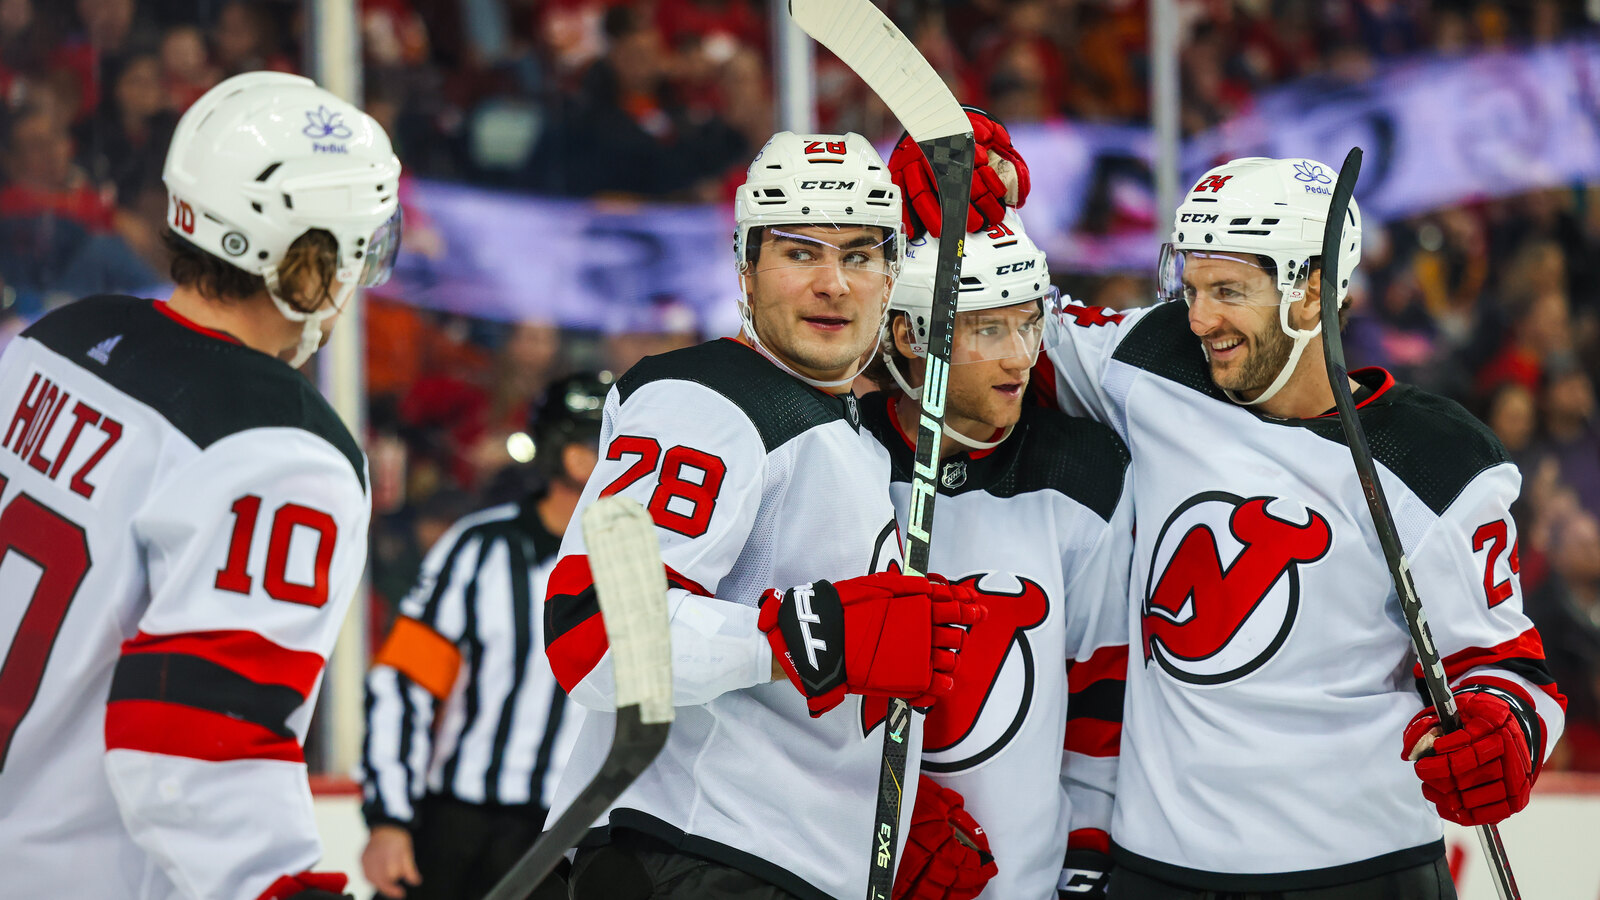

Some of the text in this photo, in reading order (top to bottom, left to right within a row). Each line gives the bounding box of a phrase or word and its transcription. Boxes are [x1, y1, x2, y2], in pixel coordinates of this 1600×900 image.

[800, 180, 856, 191] CCM
[1193, 175, 1233, 193] 24
[1180, 213, 1219, 224] CCM
[996, 259, 1035, 276] CCM
[2, 372, 124, 500] HOLTZ
[902, 352, 950, 577] TRUE
[943, 263, 961, 355] CATALYST
[597, 435, 727, 539] 28
[214, 493, 338, 609] 10
